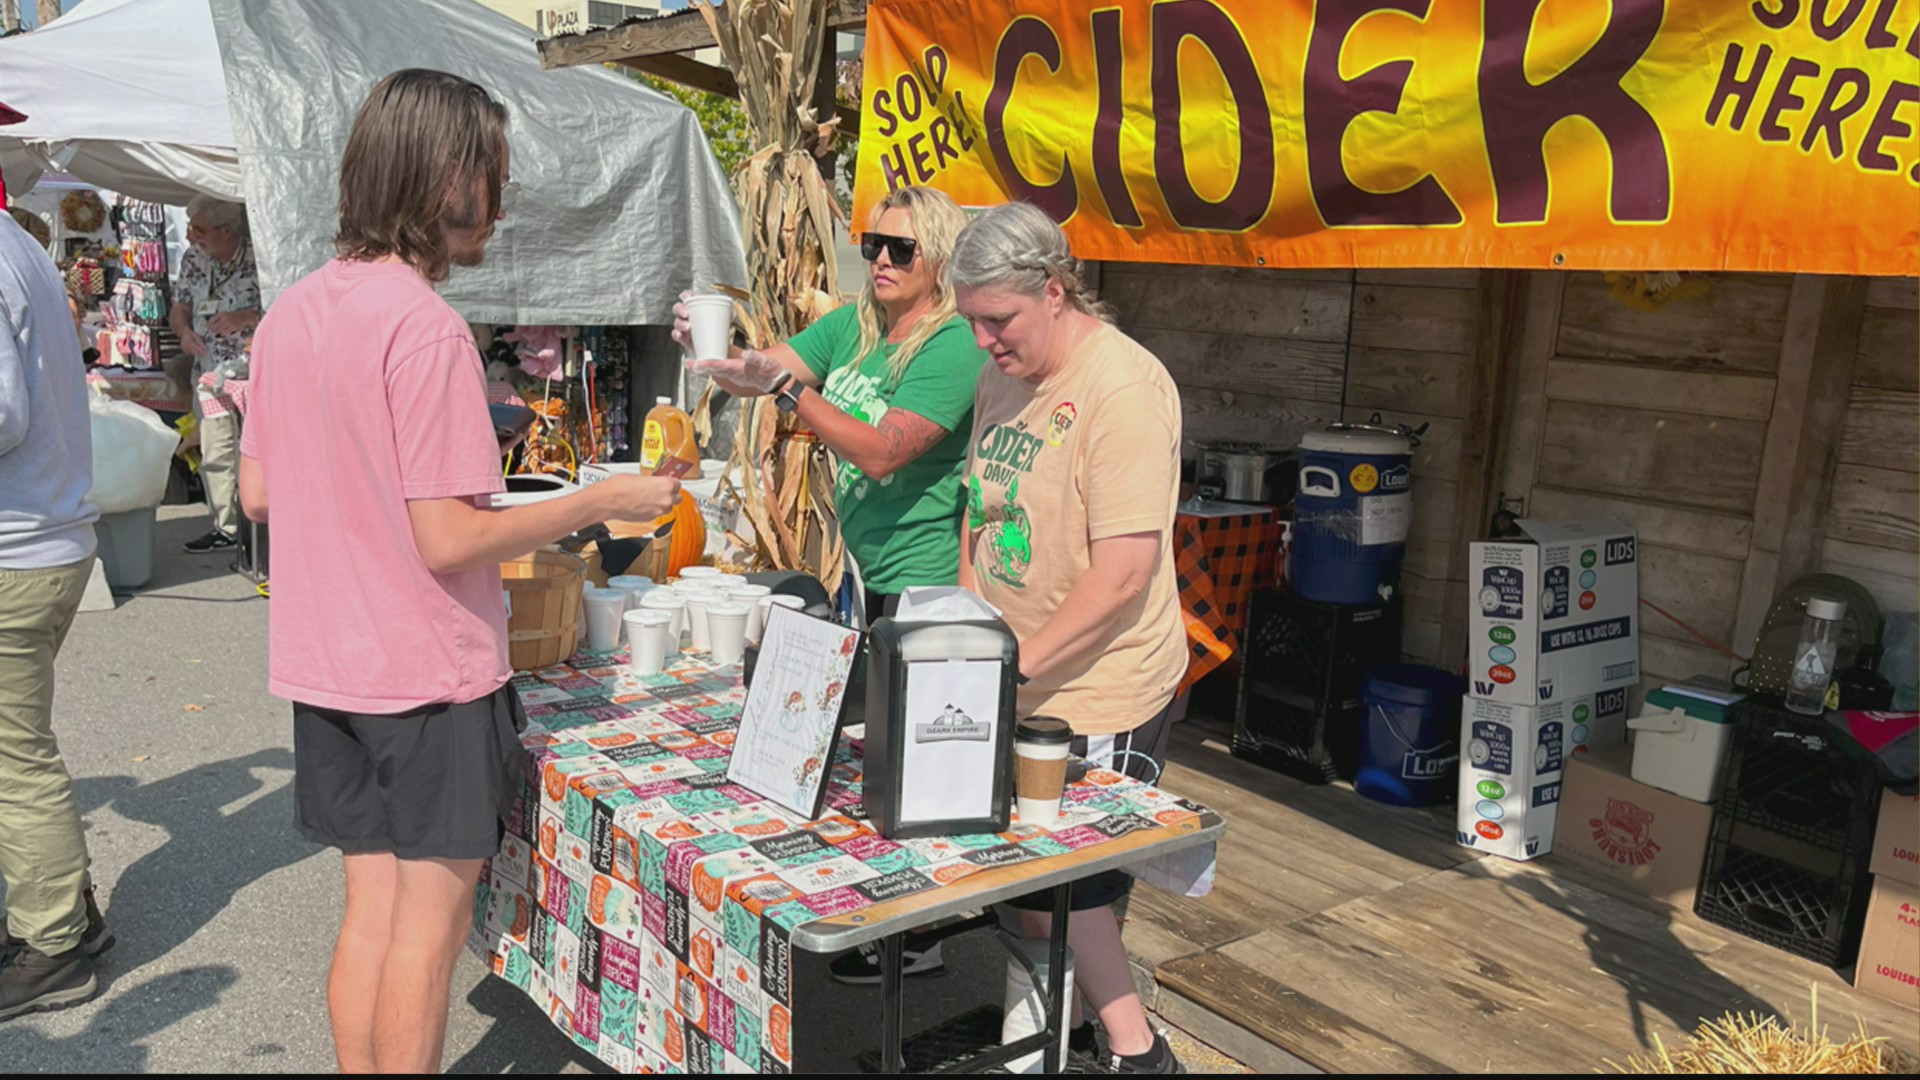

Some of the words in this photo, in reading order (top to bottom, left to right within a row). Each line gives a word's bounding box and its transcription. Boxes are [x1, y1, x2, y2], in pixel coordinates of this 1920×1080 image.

[556, 10, 579, 28] PLAZA
[873, 45, 949, 138] SOLD
[984, 0, 1672, 232] CIDER
[879, 90, 979, 192] HERE!
[977, 424, 1044, 472] CIDER
[1607, 541, 1633, 562] LIDS
[1493, 629, 1512, 641] 12oz
[1492, 668, 1512, 680] 20oz
[1598, 692, 1623, 714] LIDS
[952, 725, 979, 734] EMPIRE
[1480, 784, 1501, 796] 12oz
[1478, 824, 1501, 837] 20oz
[761, 834, 815, 852] Morning
[871, 878, 926, 897] Morning
[672, 896, 687, 954] Morning
[763, 927, 780, 991] Morning
[777, 938, 789, 1000] PUMPKIN
[605, 963, 633, 988] SPICE
[725, 1005, 735, 1049] SPICE
